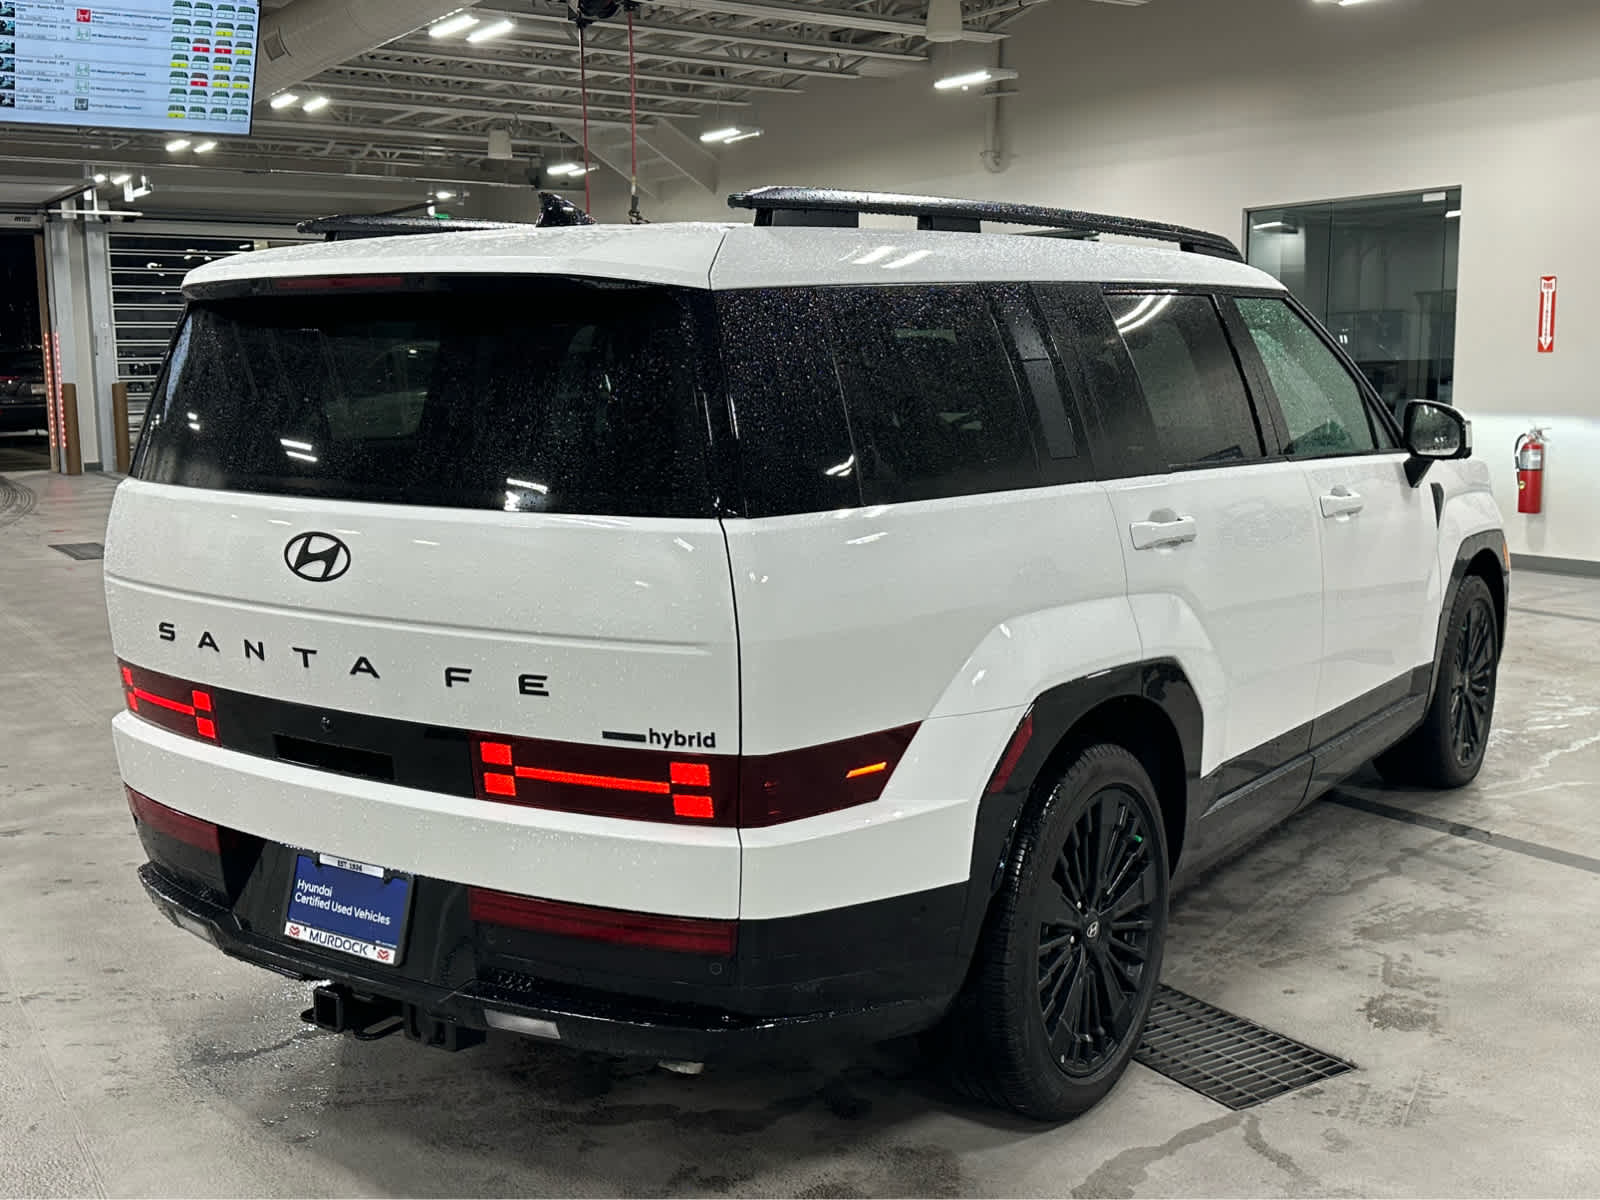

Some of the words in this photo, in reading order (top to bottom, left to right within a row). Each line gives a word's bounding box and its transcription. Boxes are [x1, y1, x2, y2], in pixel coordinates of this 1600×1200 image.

[158, 622, 379, 678] SANTA
[445, 667, 550, 696] FE
[649, 727, 716, 749] hybrid
[297, 879, 333, 897] Hyundai
[295, 892, 330, 910] Certified
[331, 901, 353, 916] Used
[354, 907, 391, 925] Vehicles
[309, 930, 368, 956] MURDOCK
